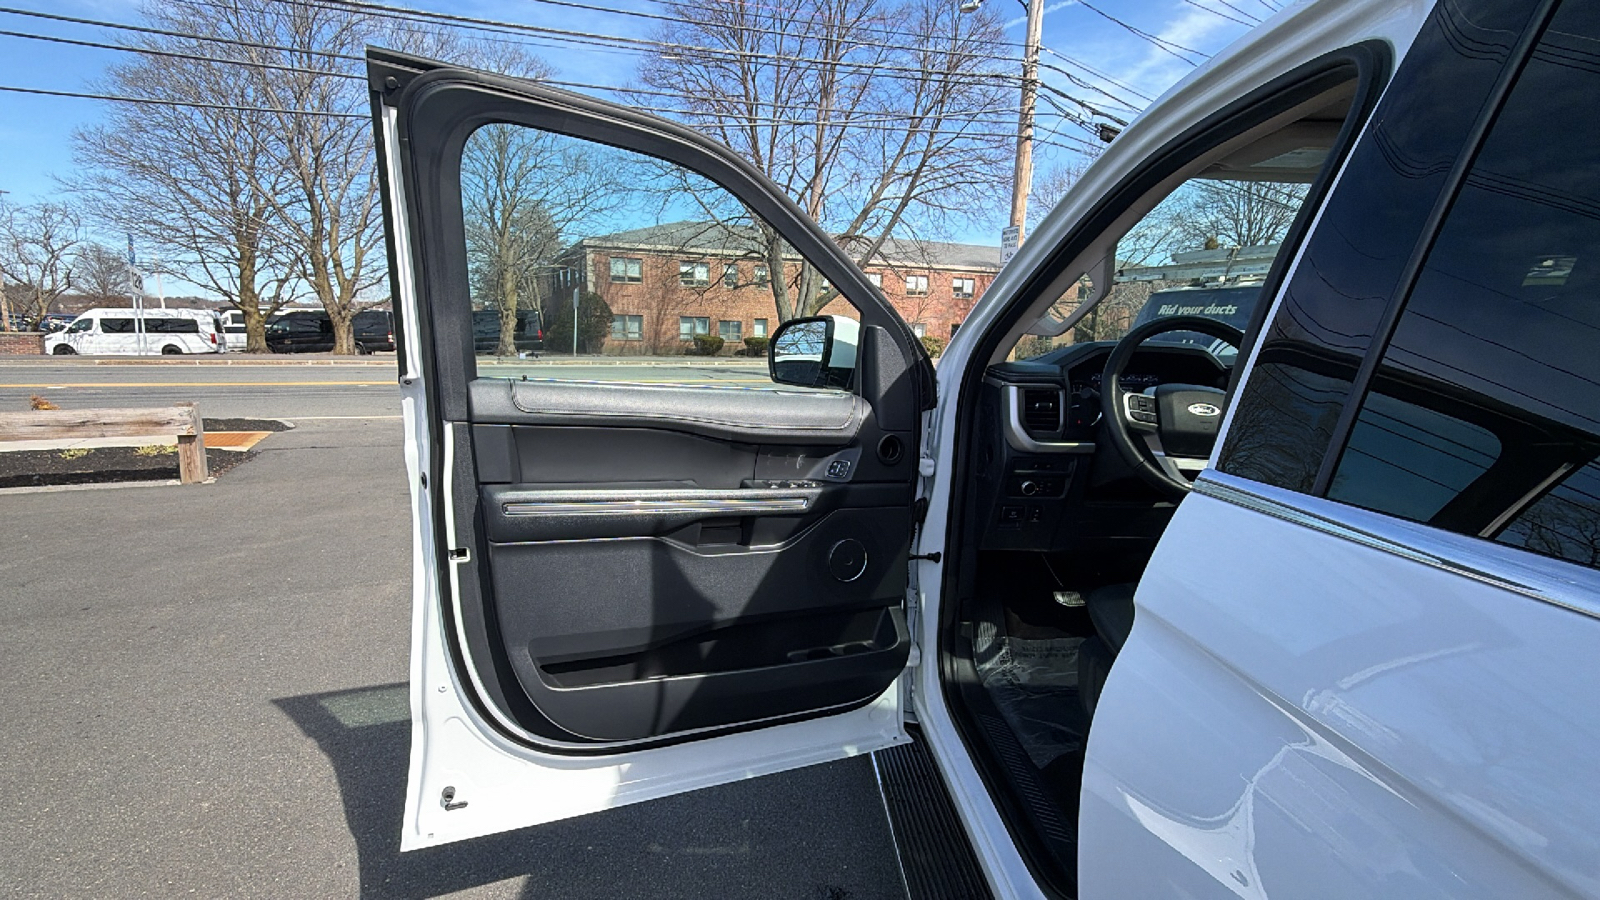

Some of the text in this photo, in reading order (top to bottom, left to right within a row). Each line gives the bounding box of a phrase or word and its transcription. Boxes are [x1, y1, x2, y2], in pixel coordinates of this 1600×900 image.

[1158, 303, 1238, 315] Rid your ducts
